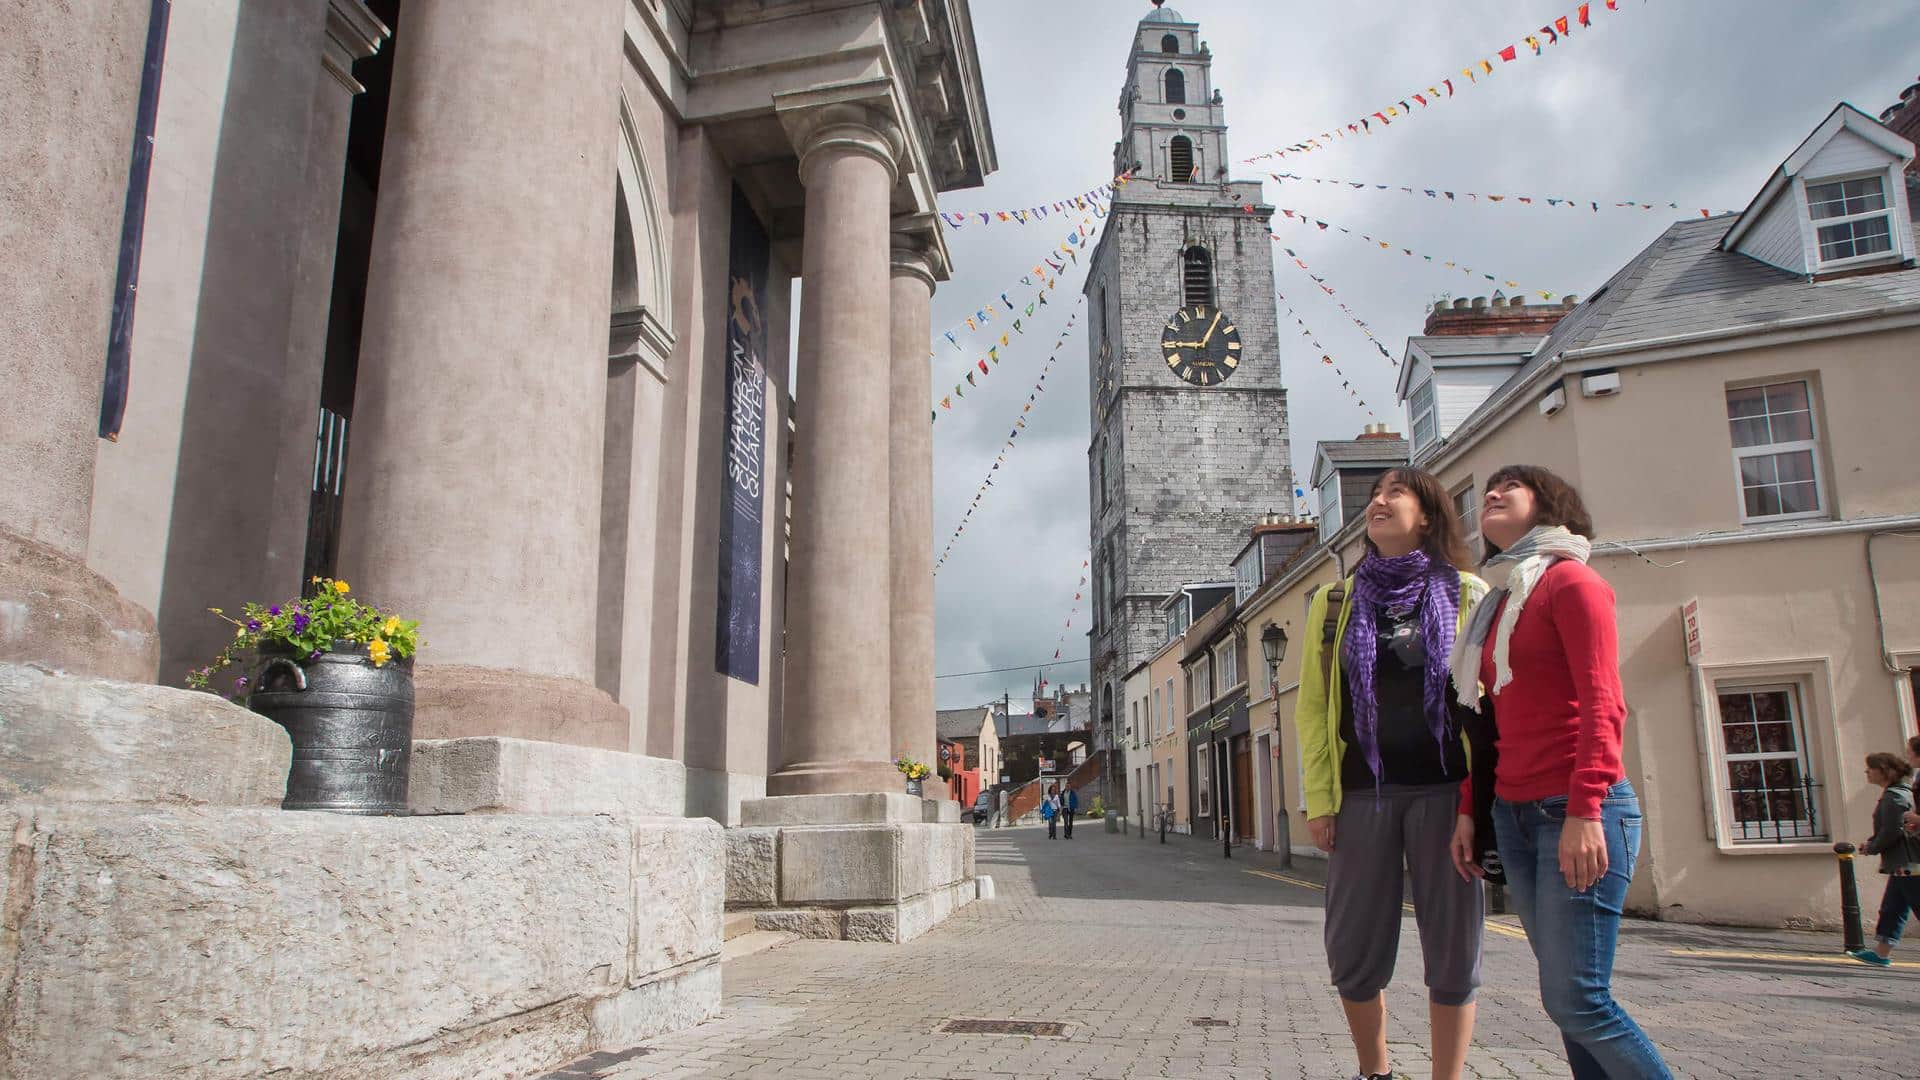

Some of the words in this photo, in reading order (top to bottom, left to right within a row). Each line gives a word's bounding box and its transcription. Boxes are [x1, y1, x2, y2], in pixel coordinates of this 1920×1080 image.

[729, 338, 745, 483] SHANDON
[739, 356, 755, 490] CULTURAL
[749, 374, 762, 498] QUARTER
